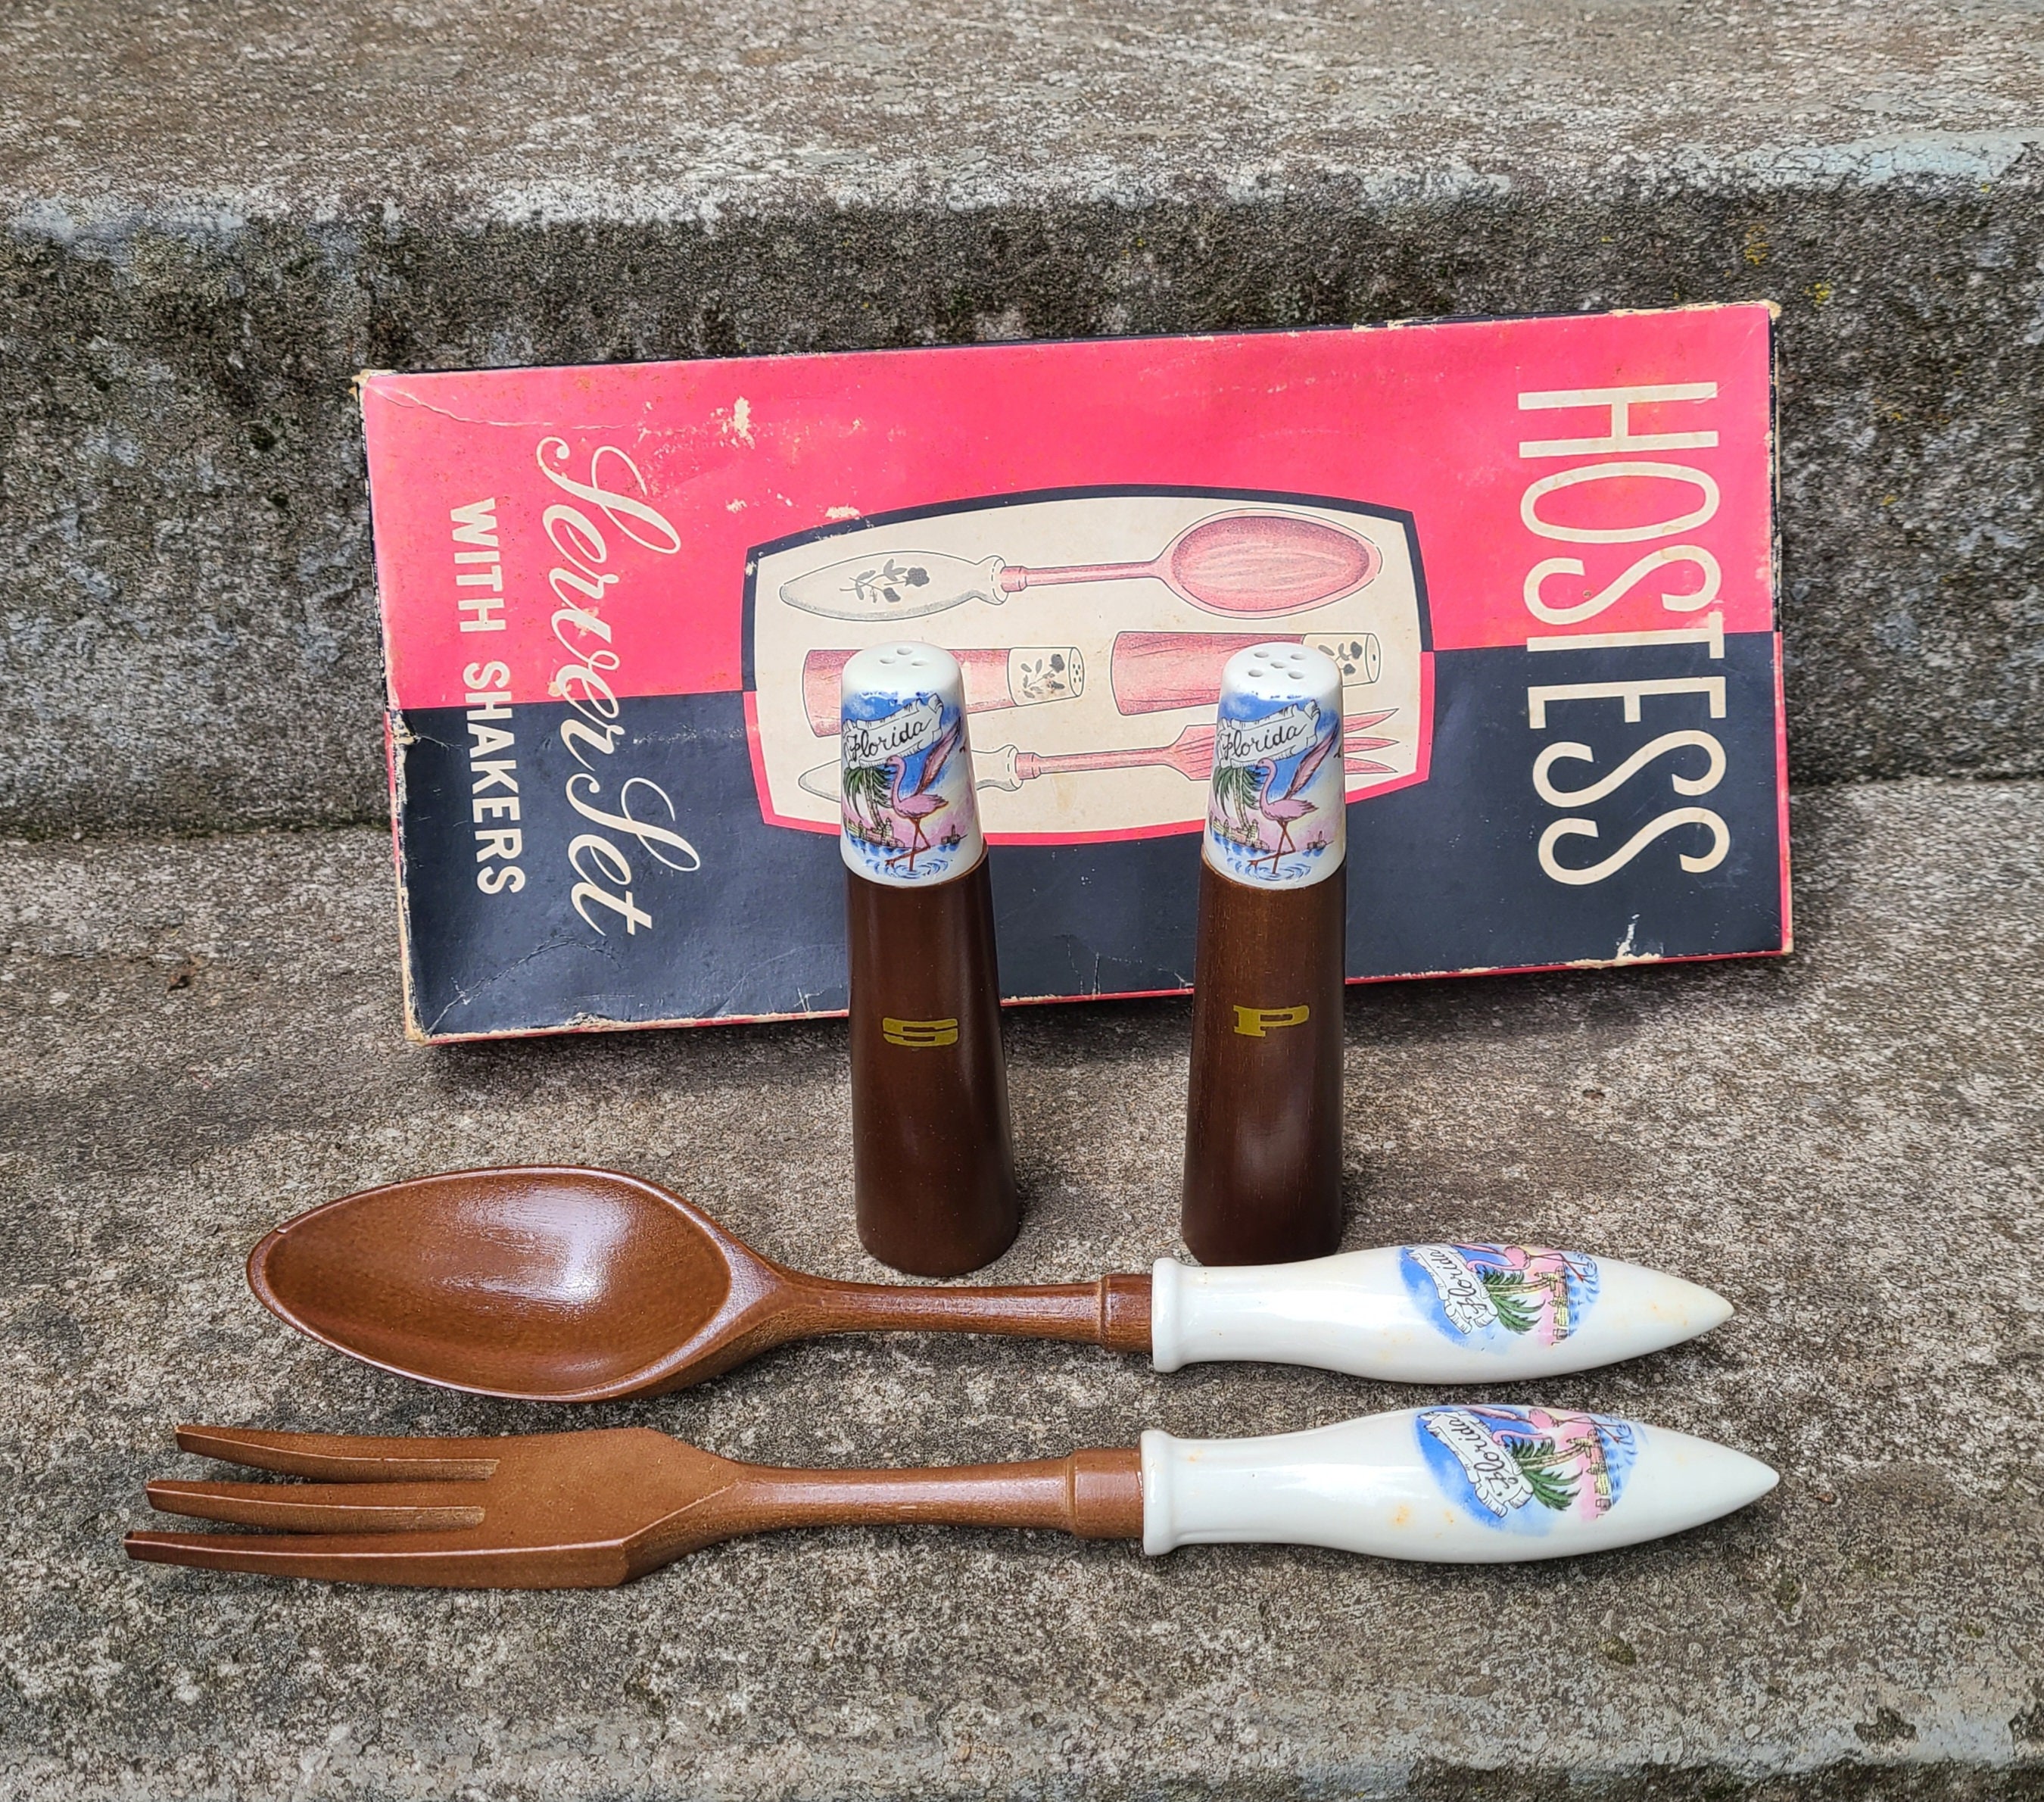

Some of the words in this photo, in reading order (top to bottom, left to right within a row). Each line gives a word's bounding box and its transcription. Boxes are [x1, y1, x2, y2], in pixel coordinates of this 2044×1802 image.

[450, 497, 506, 634] WITH
[536, 435, 682, 772] Server
[1516, 380, 1731, 886] HOSTESS
[461, 661, 525, 896] SHAKERS
[846, 718, 933, 762] Florida
[1220, 722, 1307, 761] Florida
[565, 772, 701, 937] Set
[882, 1017, 958, 1048] S
[1233, 1003, 1310, 1038] P
[1427, 1248, 1488, 1320] Florida
[1450, 1417, 1519, 1496] Florida
